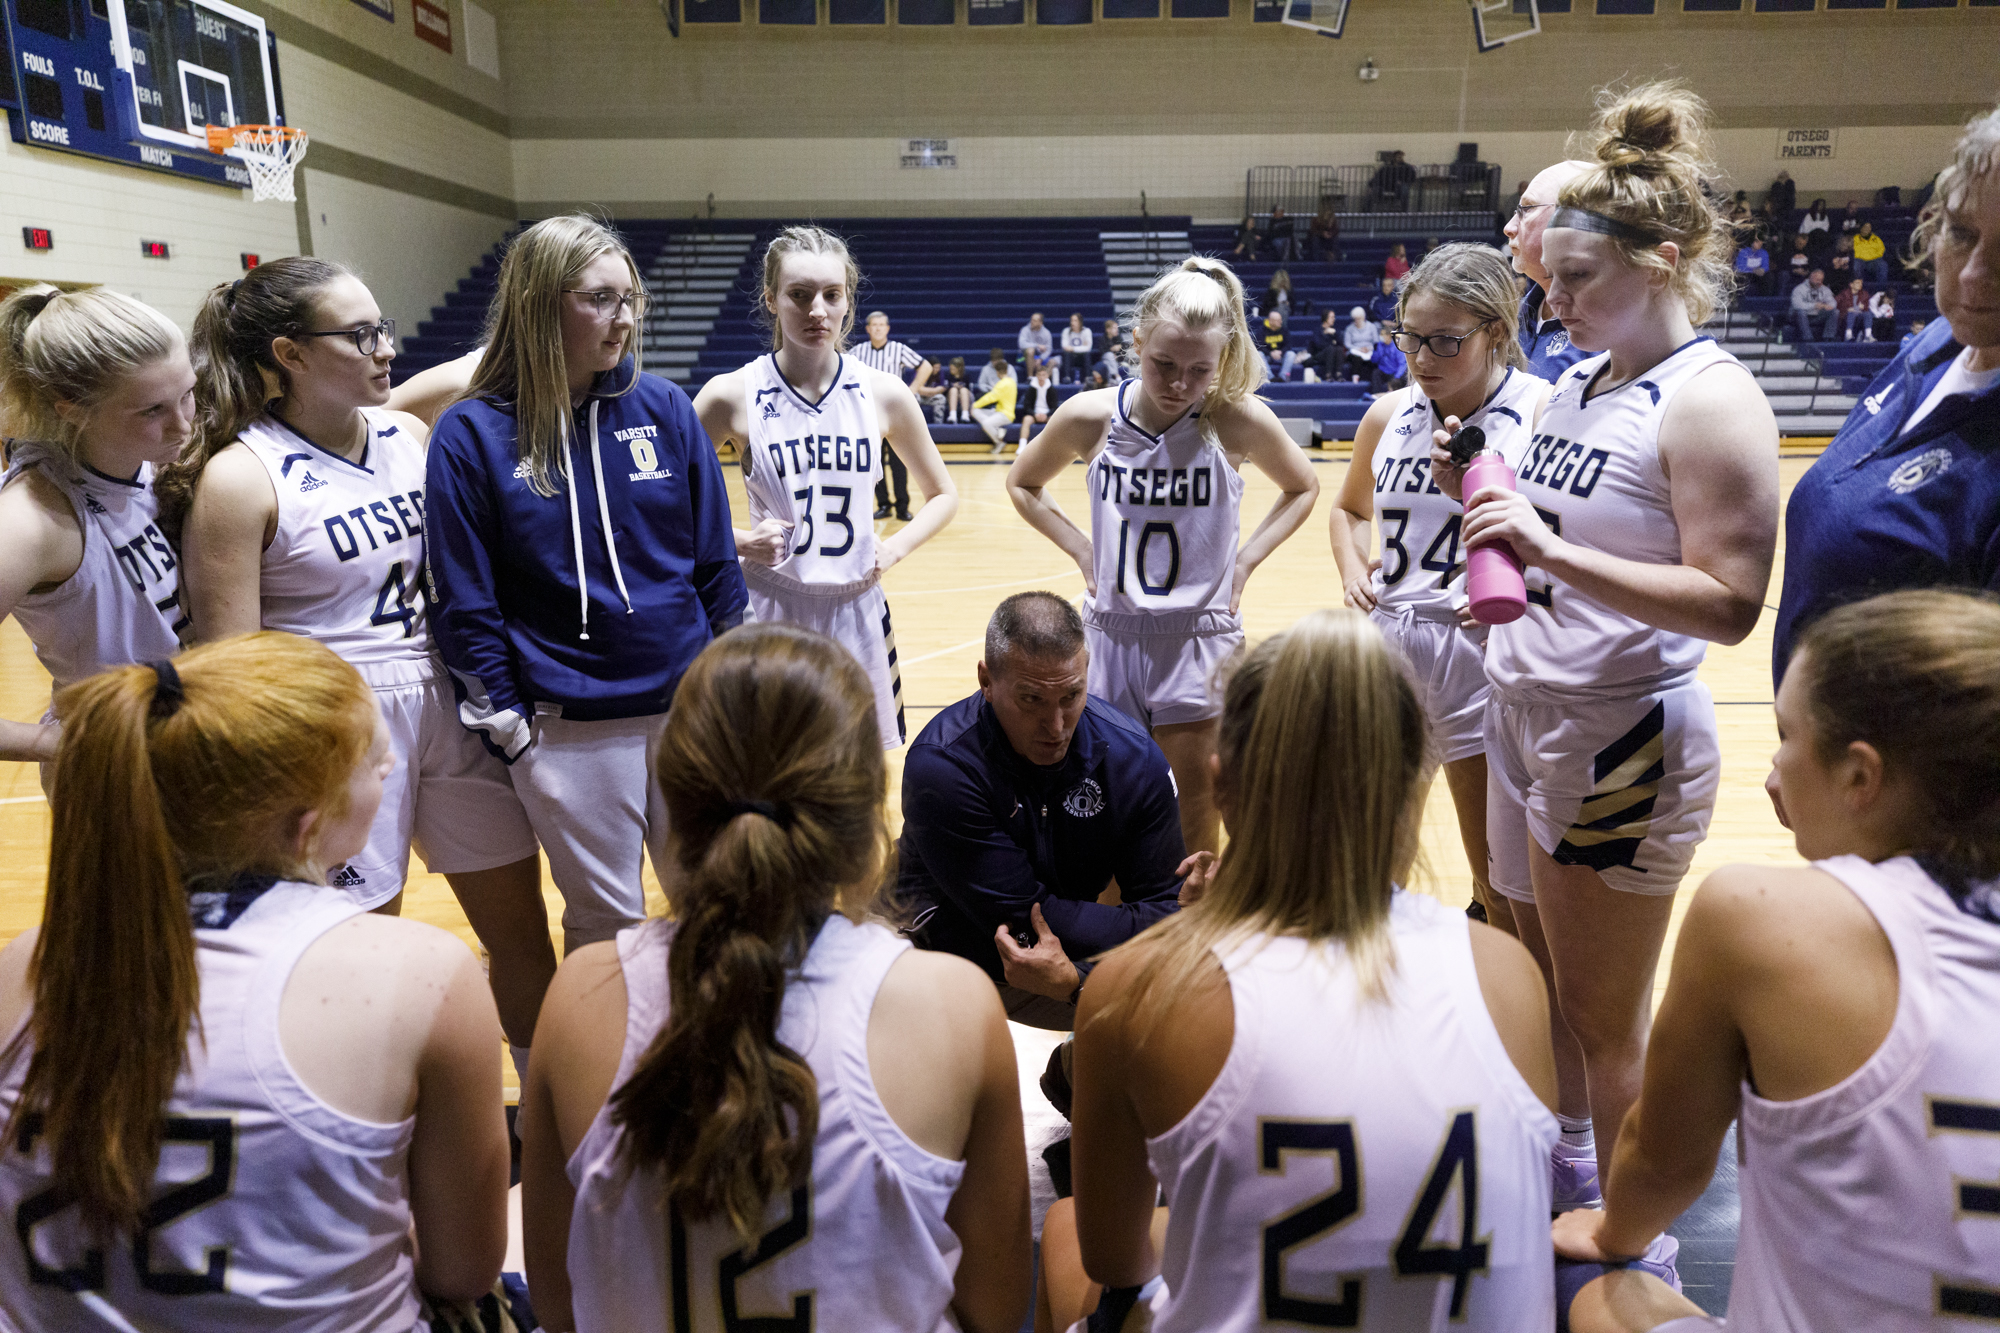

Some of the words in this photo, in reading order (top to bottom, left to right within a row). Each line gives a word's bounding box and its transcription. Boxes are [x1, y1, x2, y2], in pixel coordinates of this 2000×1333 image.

[23, 51, 55, 77] FOULS
[74, 67, 105, 91] T.O.L.
[30, 120, 70, 145] SCORE
[1787, 130, 1830, 142] OTSEGO
[140, 145, 173, 168] MATCH
[1782, 145, 1831, 157] PARENTS
[613, 425, 658, 442] VARSITY
[768, 434, 872, 478] OTSEGO
[1519, 433, 1610, 500] SEGO
[629, 468, 673, 482] BASKETBALL
[1099, 463, 1212, 507] OTSEGO
[323, 489, 424, 563] OTSE
[793, 483, 856, 559] 33
[1115, 517, 1182, 599] 10
[1381, 507, 1467, 590] 34
[368, 558, 418, 640] 4
[1062, 800, 1107, 818] BASKETBALL
[1257, 1105, 1493, 1332] 24
